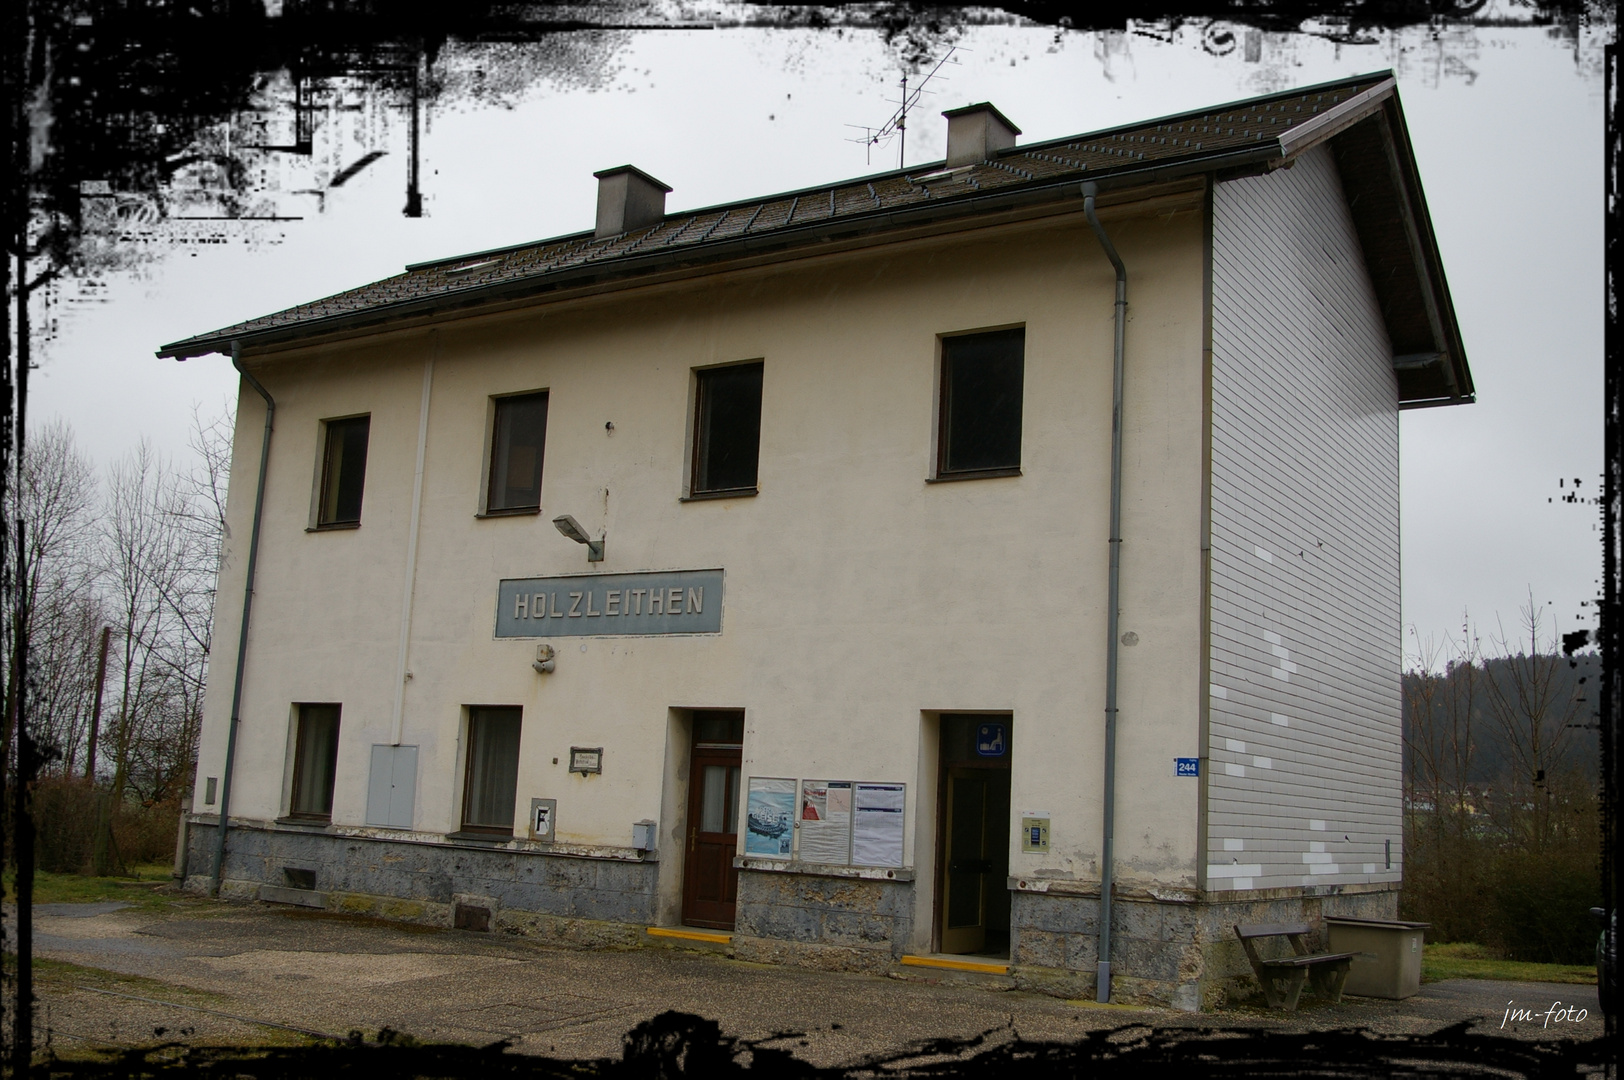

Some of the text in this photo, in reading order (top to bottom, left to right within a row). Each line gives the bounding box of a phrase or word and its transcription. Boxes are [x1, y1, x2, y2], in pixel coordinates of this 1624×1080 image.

[514, 586, 704, 619] HOLZLEITHEN
[1179, 763, 1196, 772] 244
[536, 809, 548, 831] F
